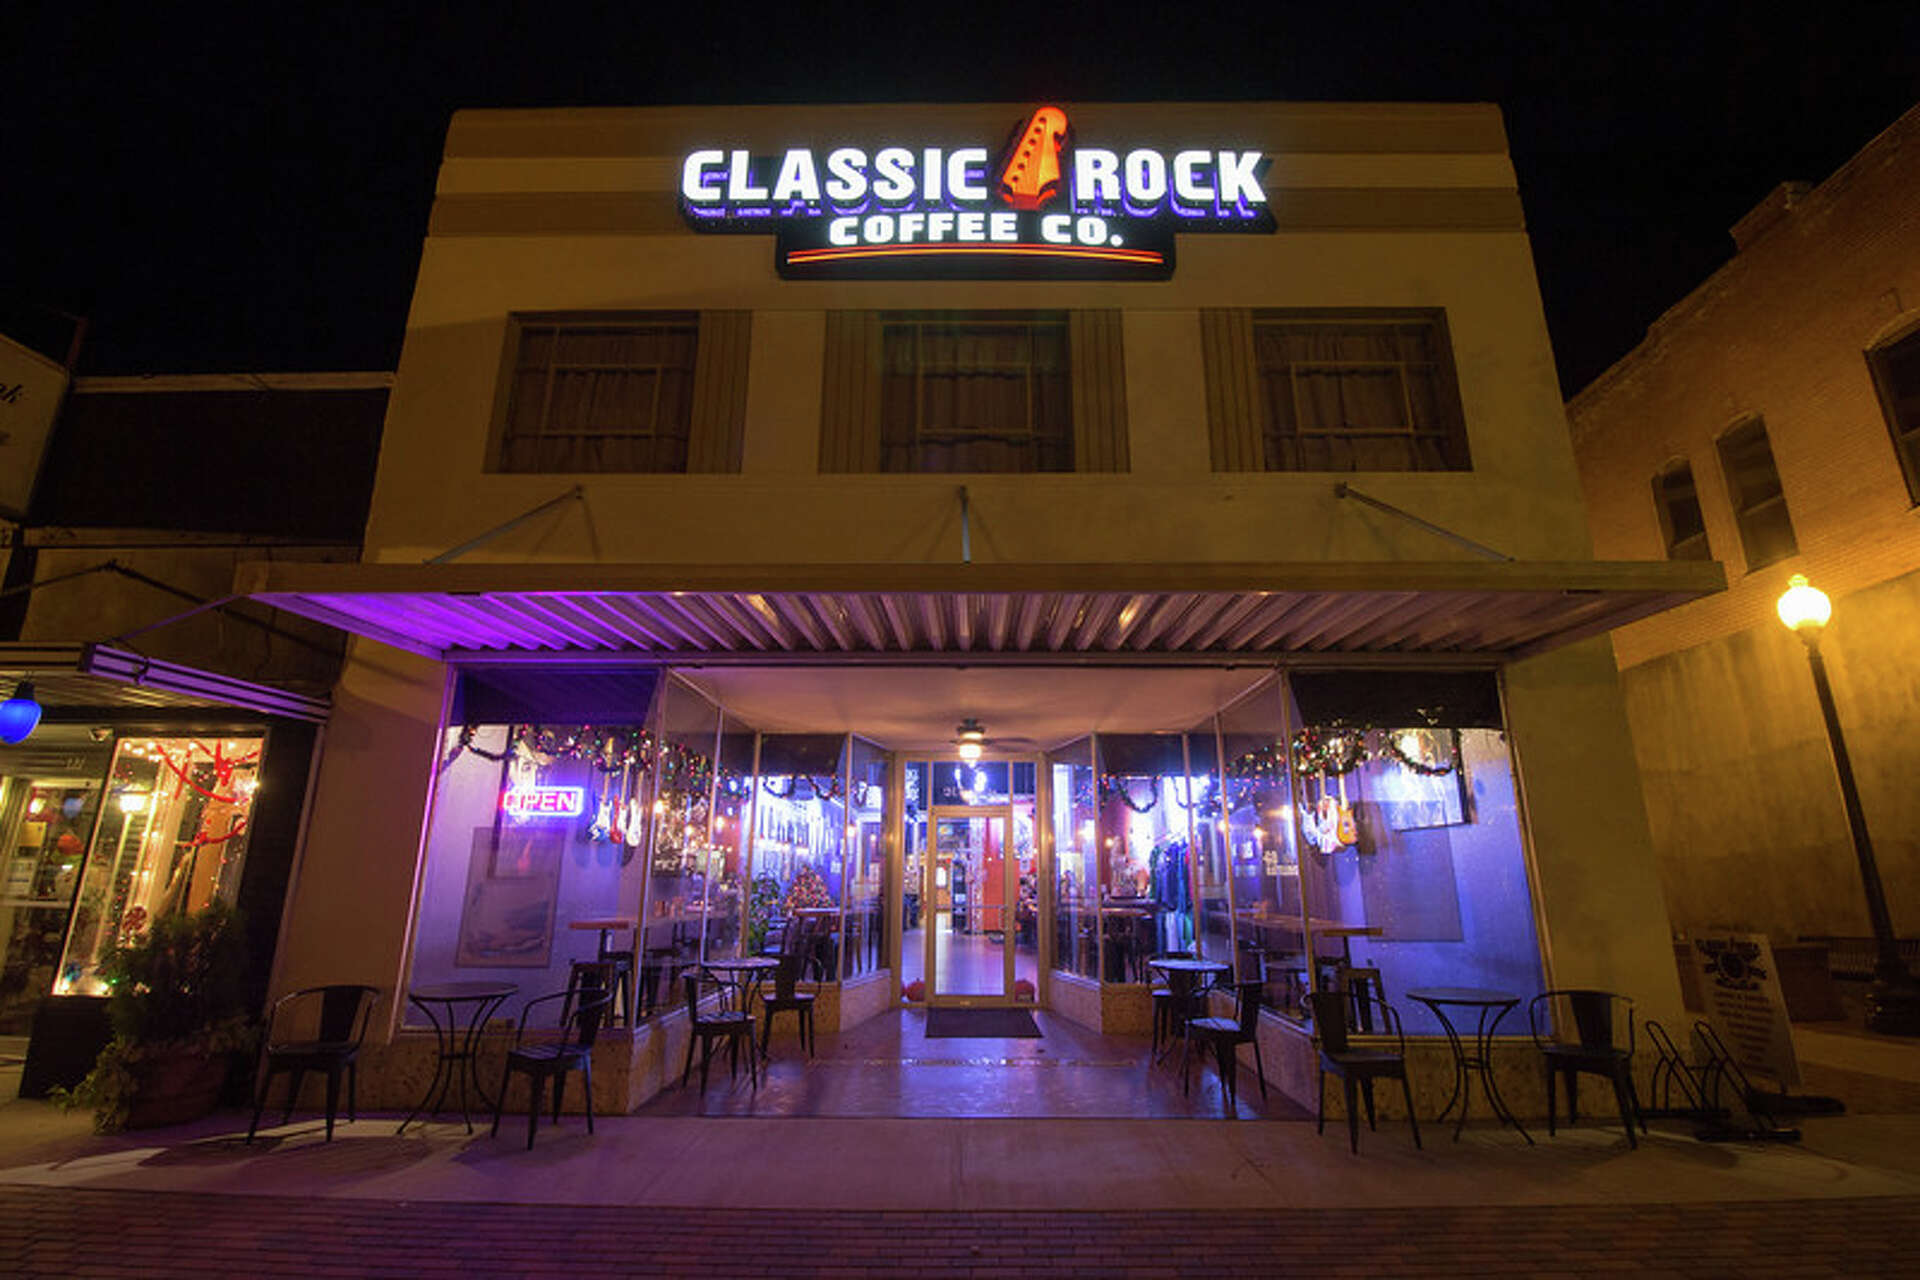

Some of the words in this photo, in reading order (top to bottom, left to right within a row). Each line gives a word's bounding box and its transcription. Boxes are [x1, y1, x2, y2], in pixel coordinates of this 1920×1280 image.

[682, 148, 988, 202] CLASSIC
[1074, 149, 1269, 203] ROCK
[829, 212, 1019, 246] COFFEE
[1041, 215, 1124, 247] CO.
[504, 791, 576, 813] OPEN
